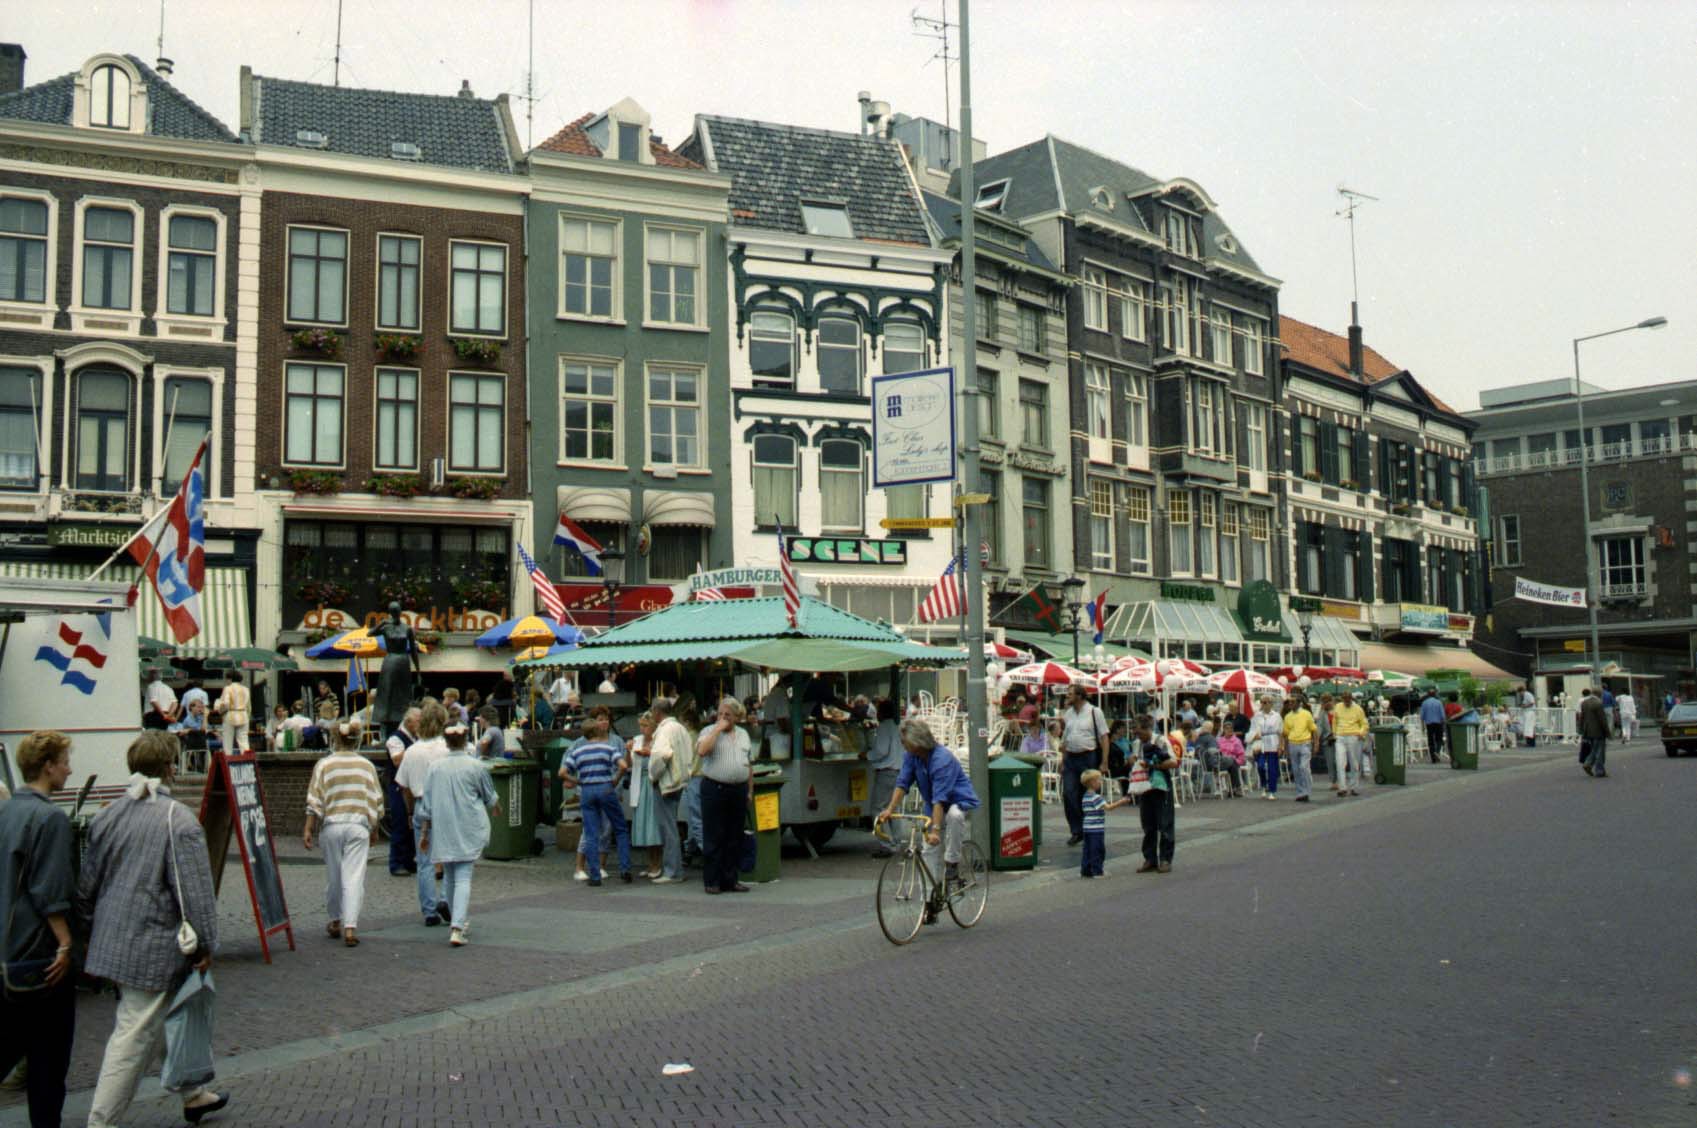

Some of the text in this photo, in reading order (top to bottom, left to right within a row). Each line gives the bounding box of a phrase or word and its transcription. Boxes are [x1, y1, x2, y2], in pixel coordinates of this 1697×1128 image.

[791, 540, 905, 563] SCENE
[1517, 581, 1570, 602] Heineken Bier
[304, 604, 344, 630] de
